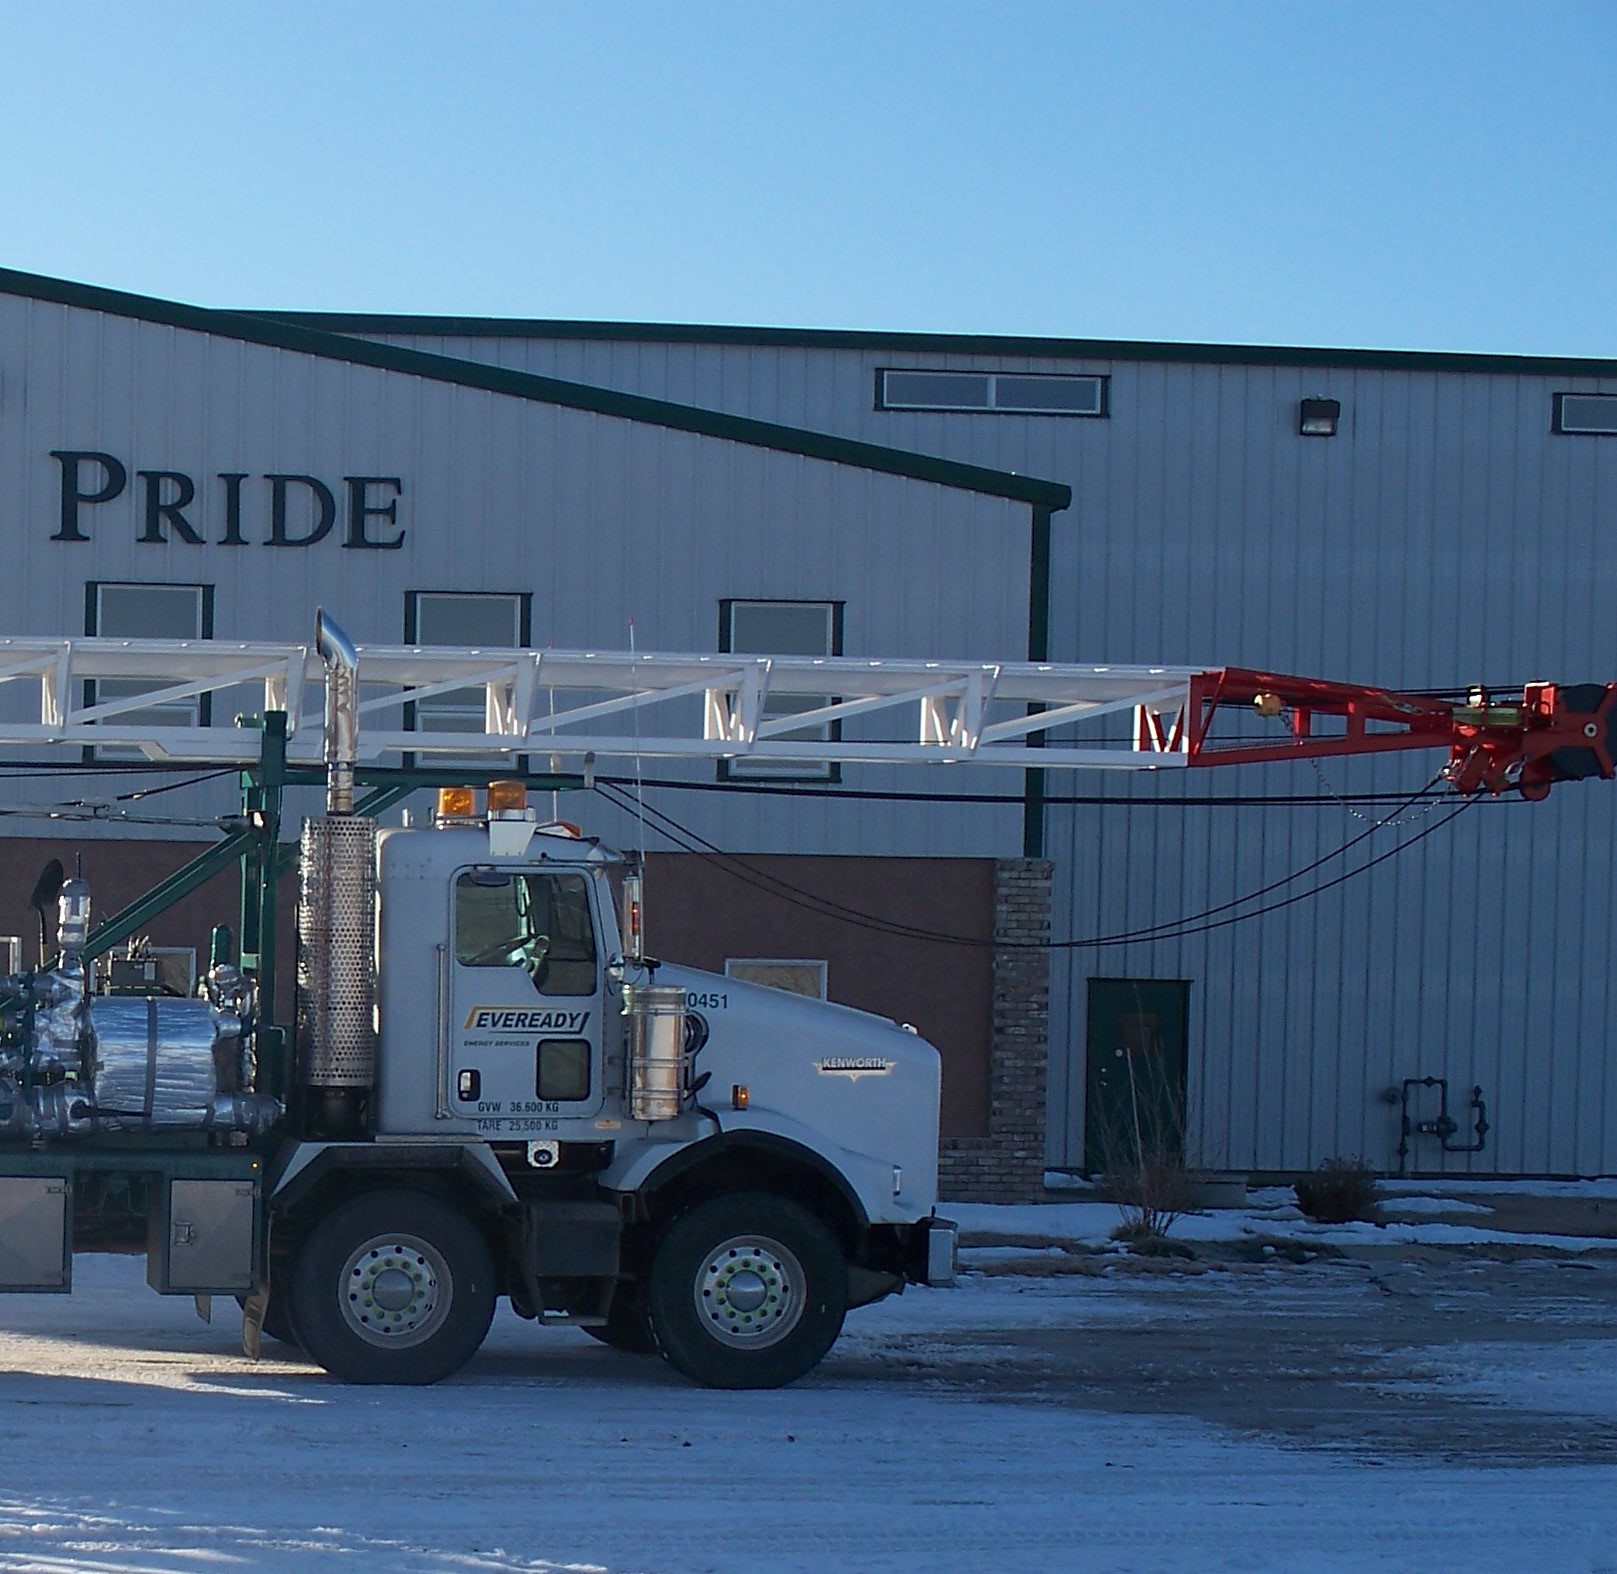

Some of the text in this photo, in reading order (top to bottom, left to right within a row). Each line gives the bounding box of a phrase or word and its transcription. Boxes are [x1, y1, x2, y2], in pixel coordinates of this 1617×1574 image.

[49, 450, 406, 549] PRIDE
[687, 992, 728, 1009] 0451
[475, 1012, 582, 1028] EVEREADY
[822, 1057, 886, 1068] KENWORTH
[478, 1101, 502, 1112] GVW
[546, 1102, 559, 1112] KG
[477, 1120, 501, 1131] TARE
[545, 1121, 558, 1131] KG
